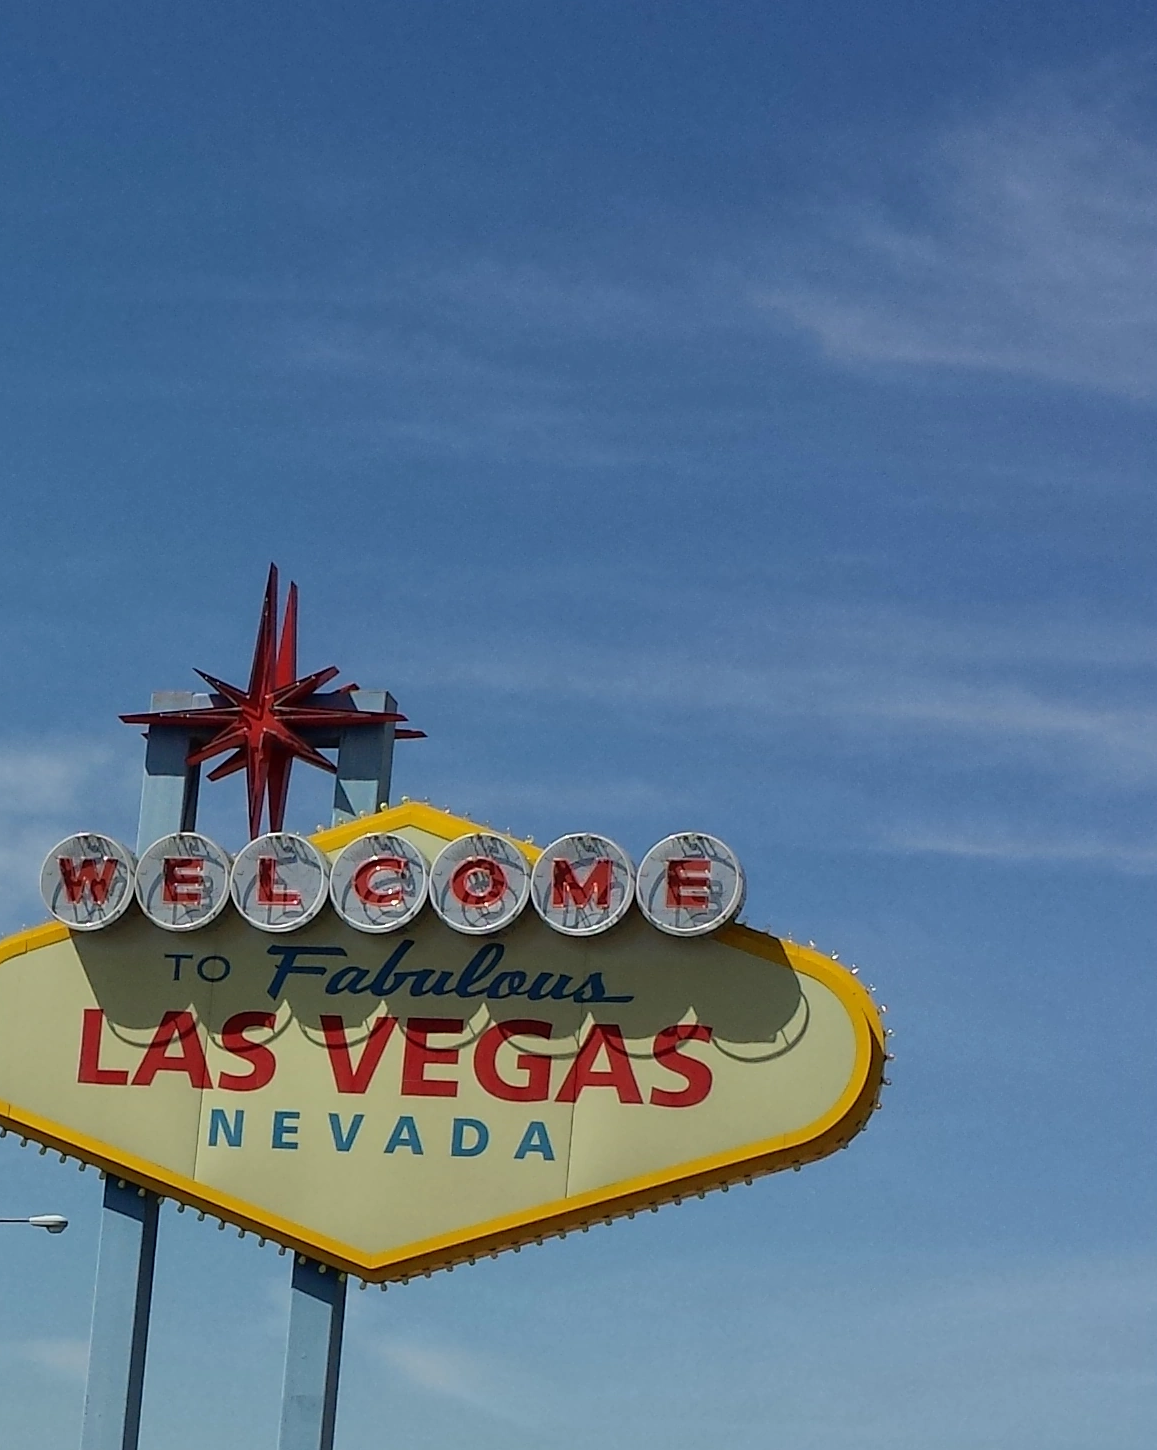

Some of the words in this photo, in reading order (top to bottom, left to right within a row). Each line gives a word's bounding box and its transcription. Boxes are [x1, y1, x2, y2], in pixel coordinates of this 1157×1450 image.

[57, 855, 712, 909] WELCOME
[164, 954, 231, 983] TO
[266, 939, 635, 1003] Fabulous
[77, 1008, 277, 1093] LAS
[320, 1014, 714, 1108] VEGAS
[208, 1108, 555, 1162] NEVADA
